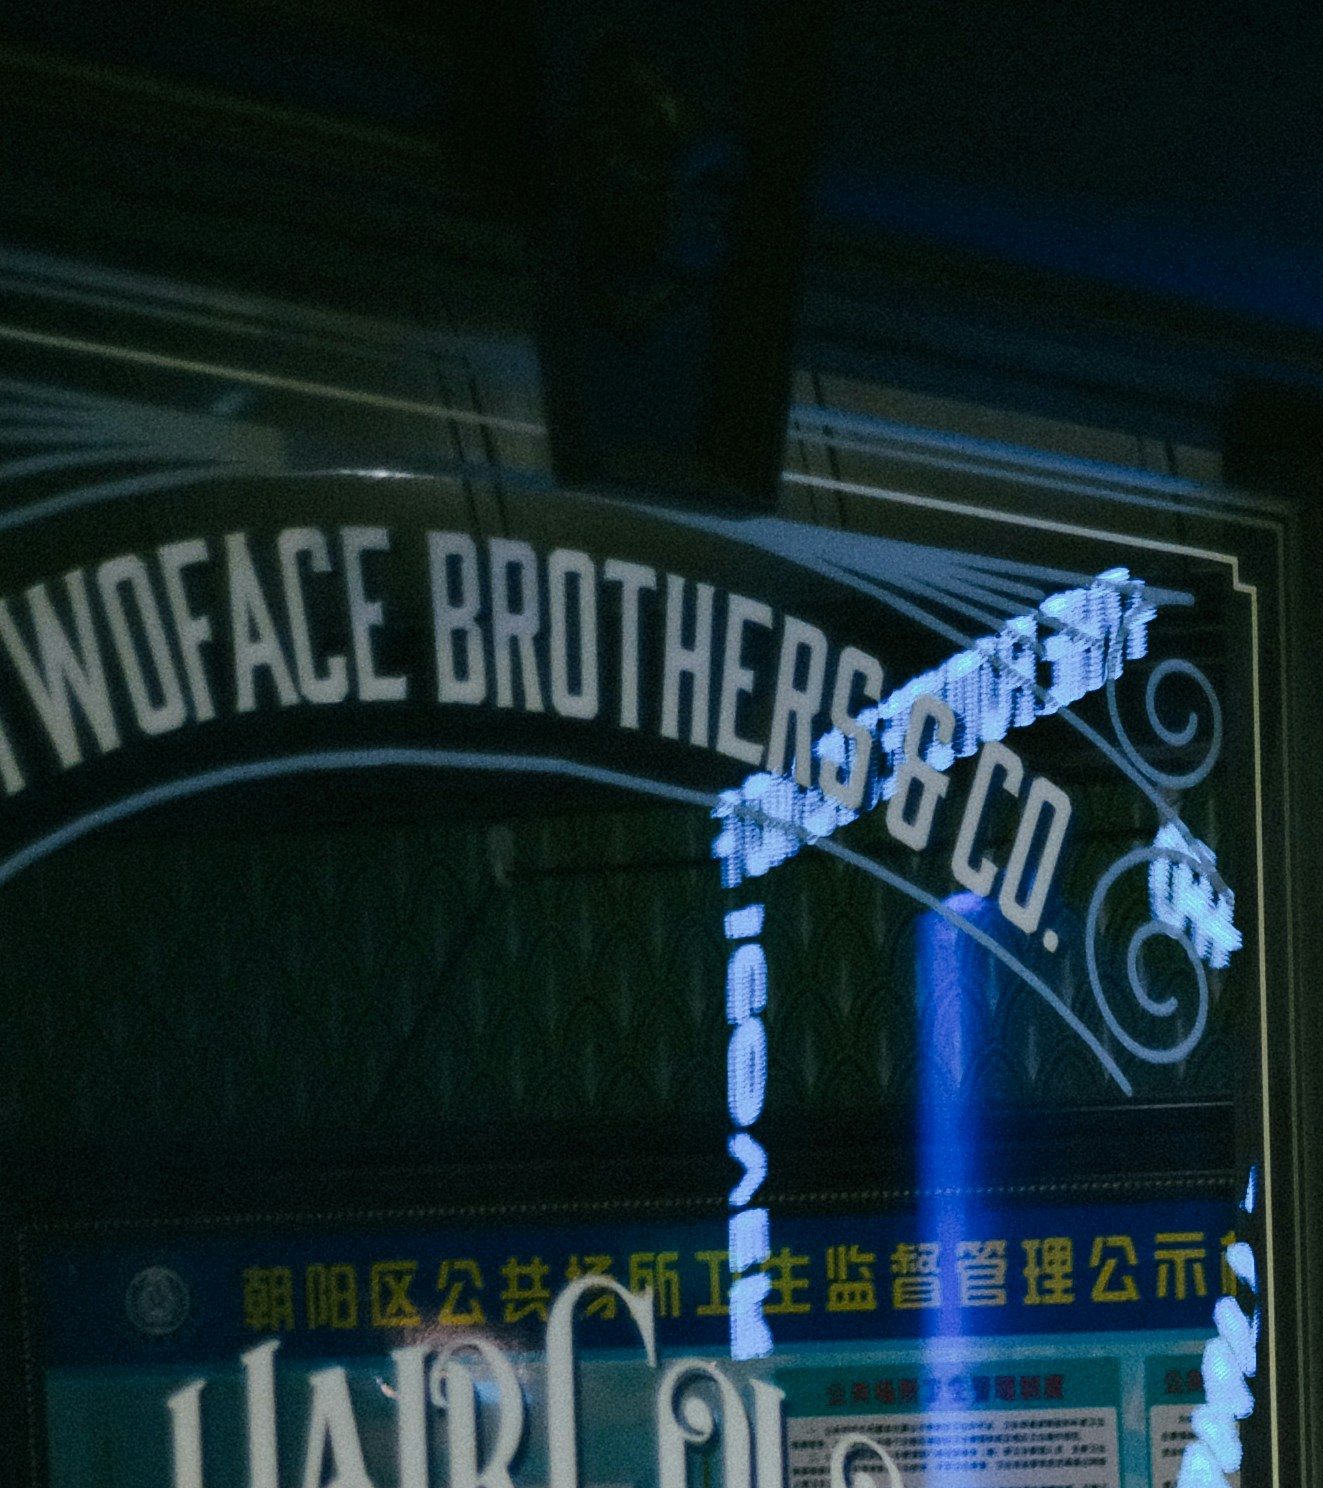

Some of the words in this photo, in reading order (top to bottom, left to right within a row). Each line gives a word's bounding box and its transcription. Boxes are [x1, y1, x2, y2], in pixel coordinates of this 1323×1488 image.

[427, 530, 885, 810] BROTHERS
[885, 693, 955, 851] &
[951, 741, 1072, 953] CO.
